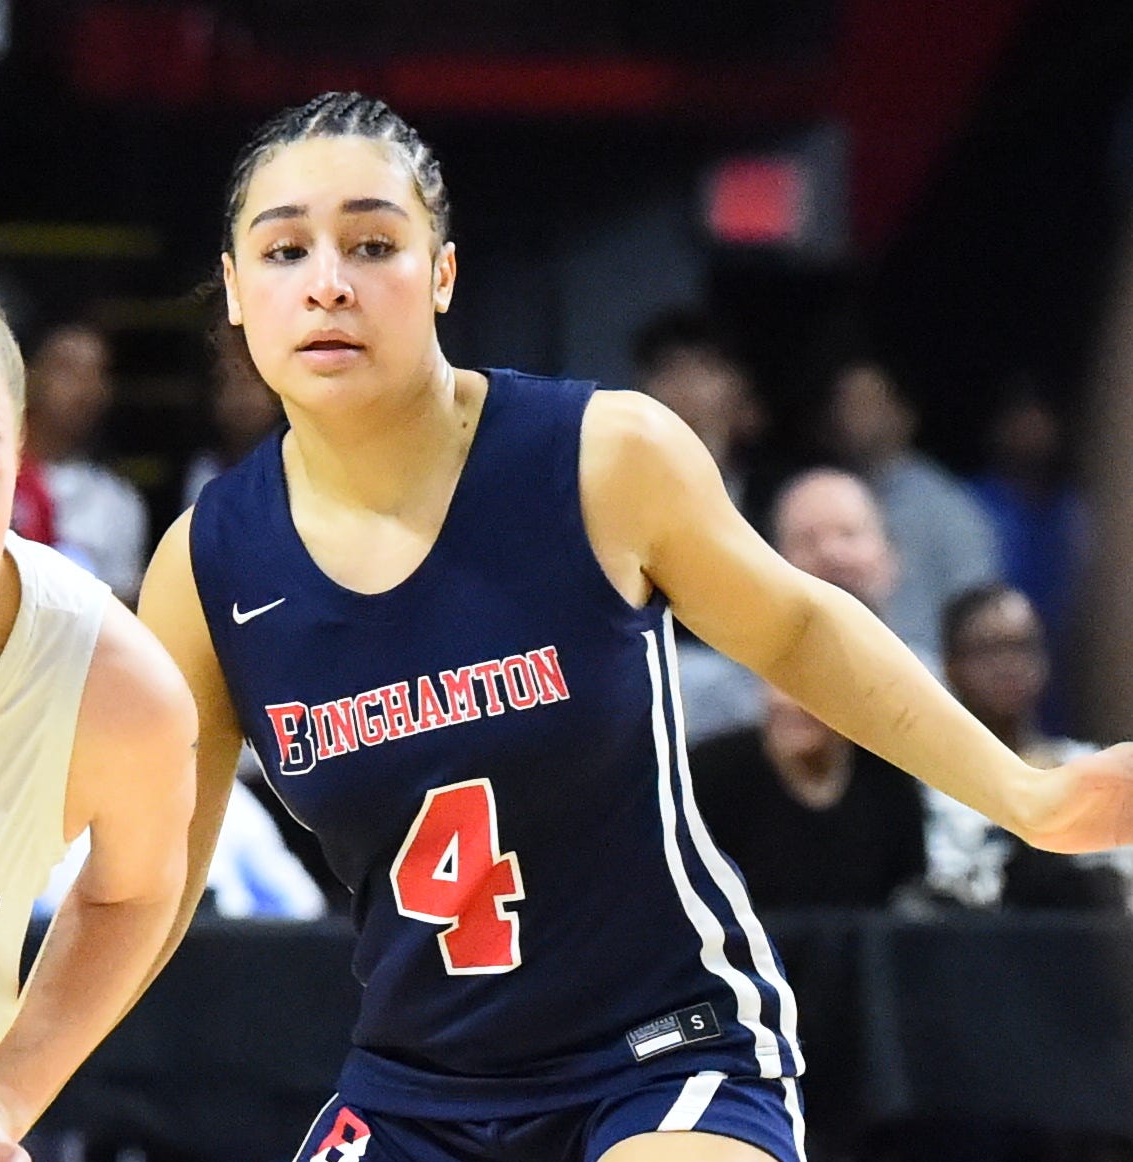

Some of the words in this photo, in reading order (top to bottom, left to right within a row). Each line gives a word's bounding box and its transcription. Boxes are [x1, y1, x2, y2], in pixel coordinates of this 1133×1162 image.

[265, 645, 570, 776] BINGHAMTON
[389, 777, 525, 976] 4
[690, 1013, 706, 1031] S
